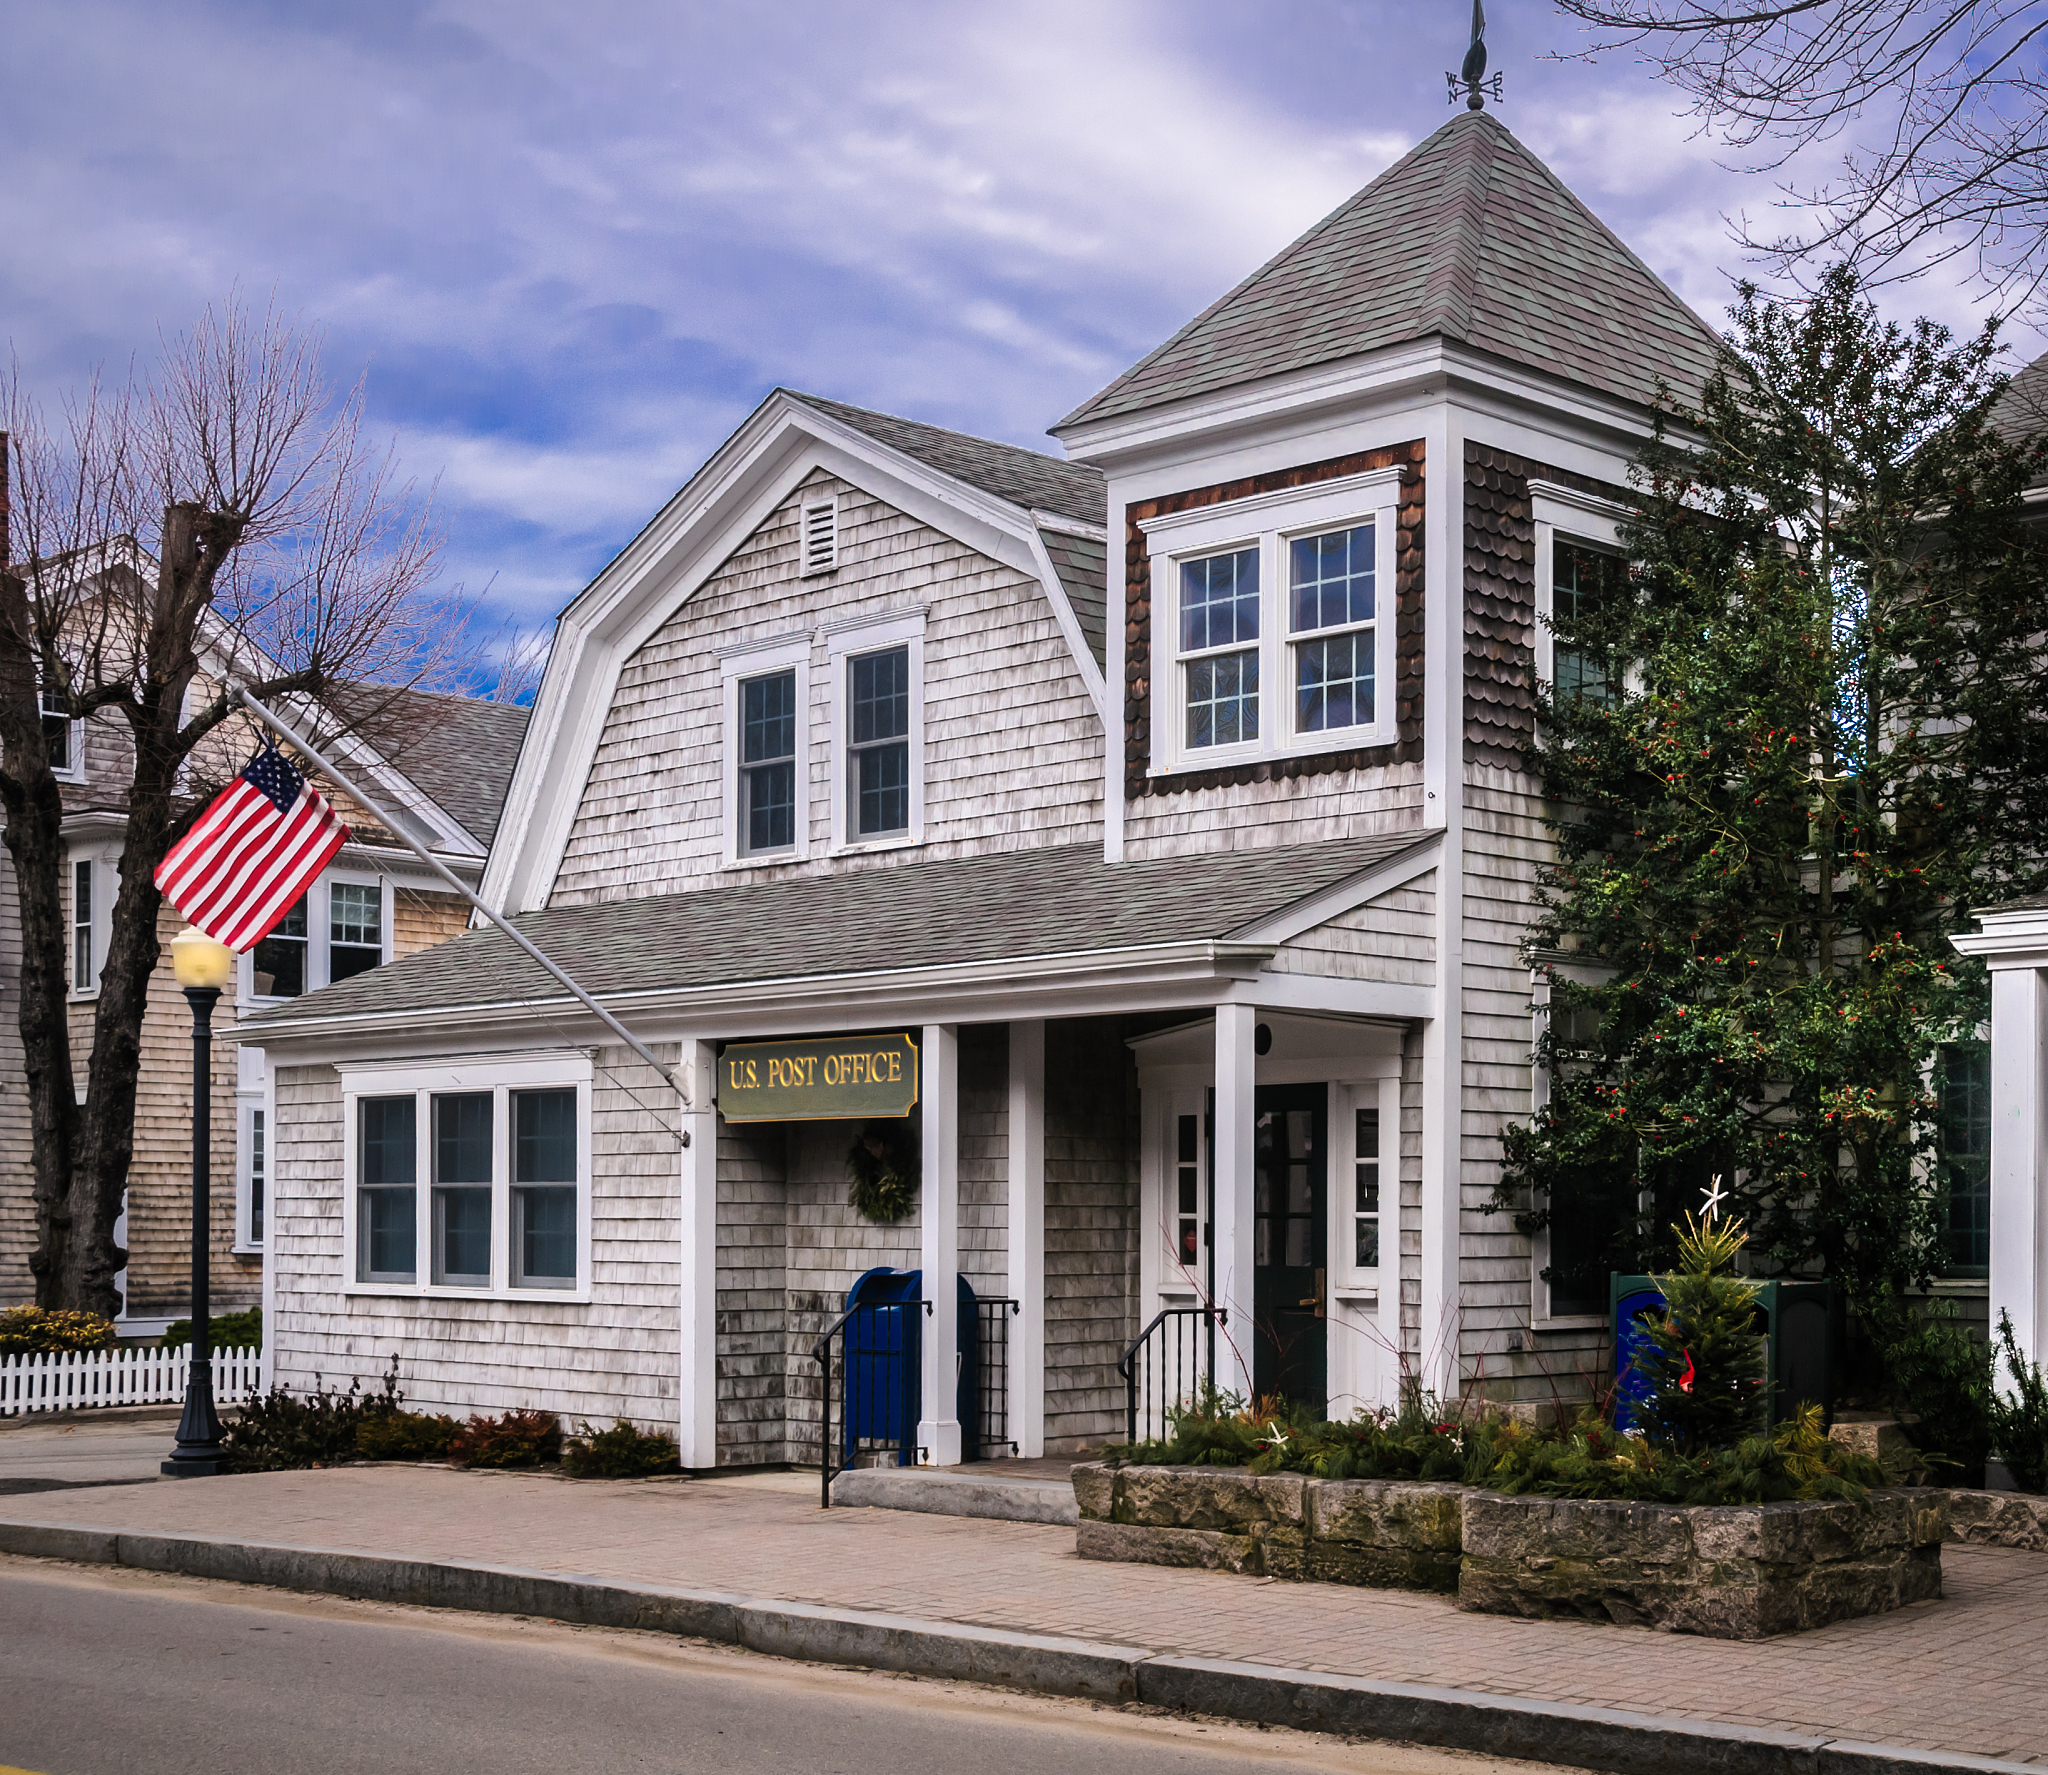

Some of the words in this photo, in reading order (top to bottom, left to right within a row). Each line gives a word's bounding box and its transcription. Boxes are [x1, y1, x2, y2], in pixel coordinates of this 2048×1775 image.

[1446, 71, 1457, 88] W
[1493, 70, 1503, 86] S
[1448, 88, 1458, 104] N
[1494, 87, 1503, 103] E
[730, 1059, 760, 1089] U.S.
[767, 1057, 818, 1087] POST
[824, 1051, 902, 1085] OFFICE
